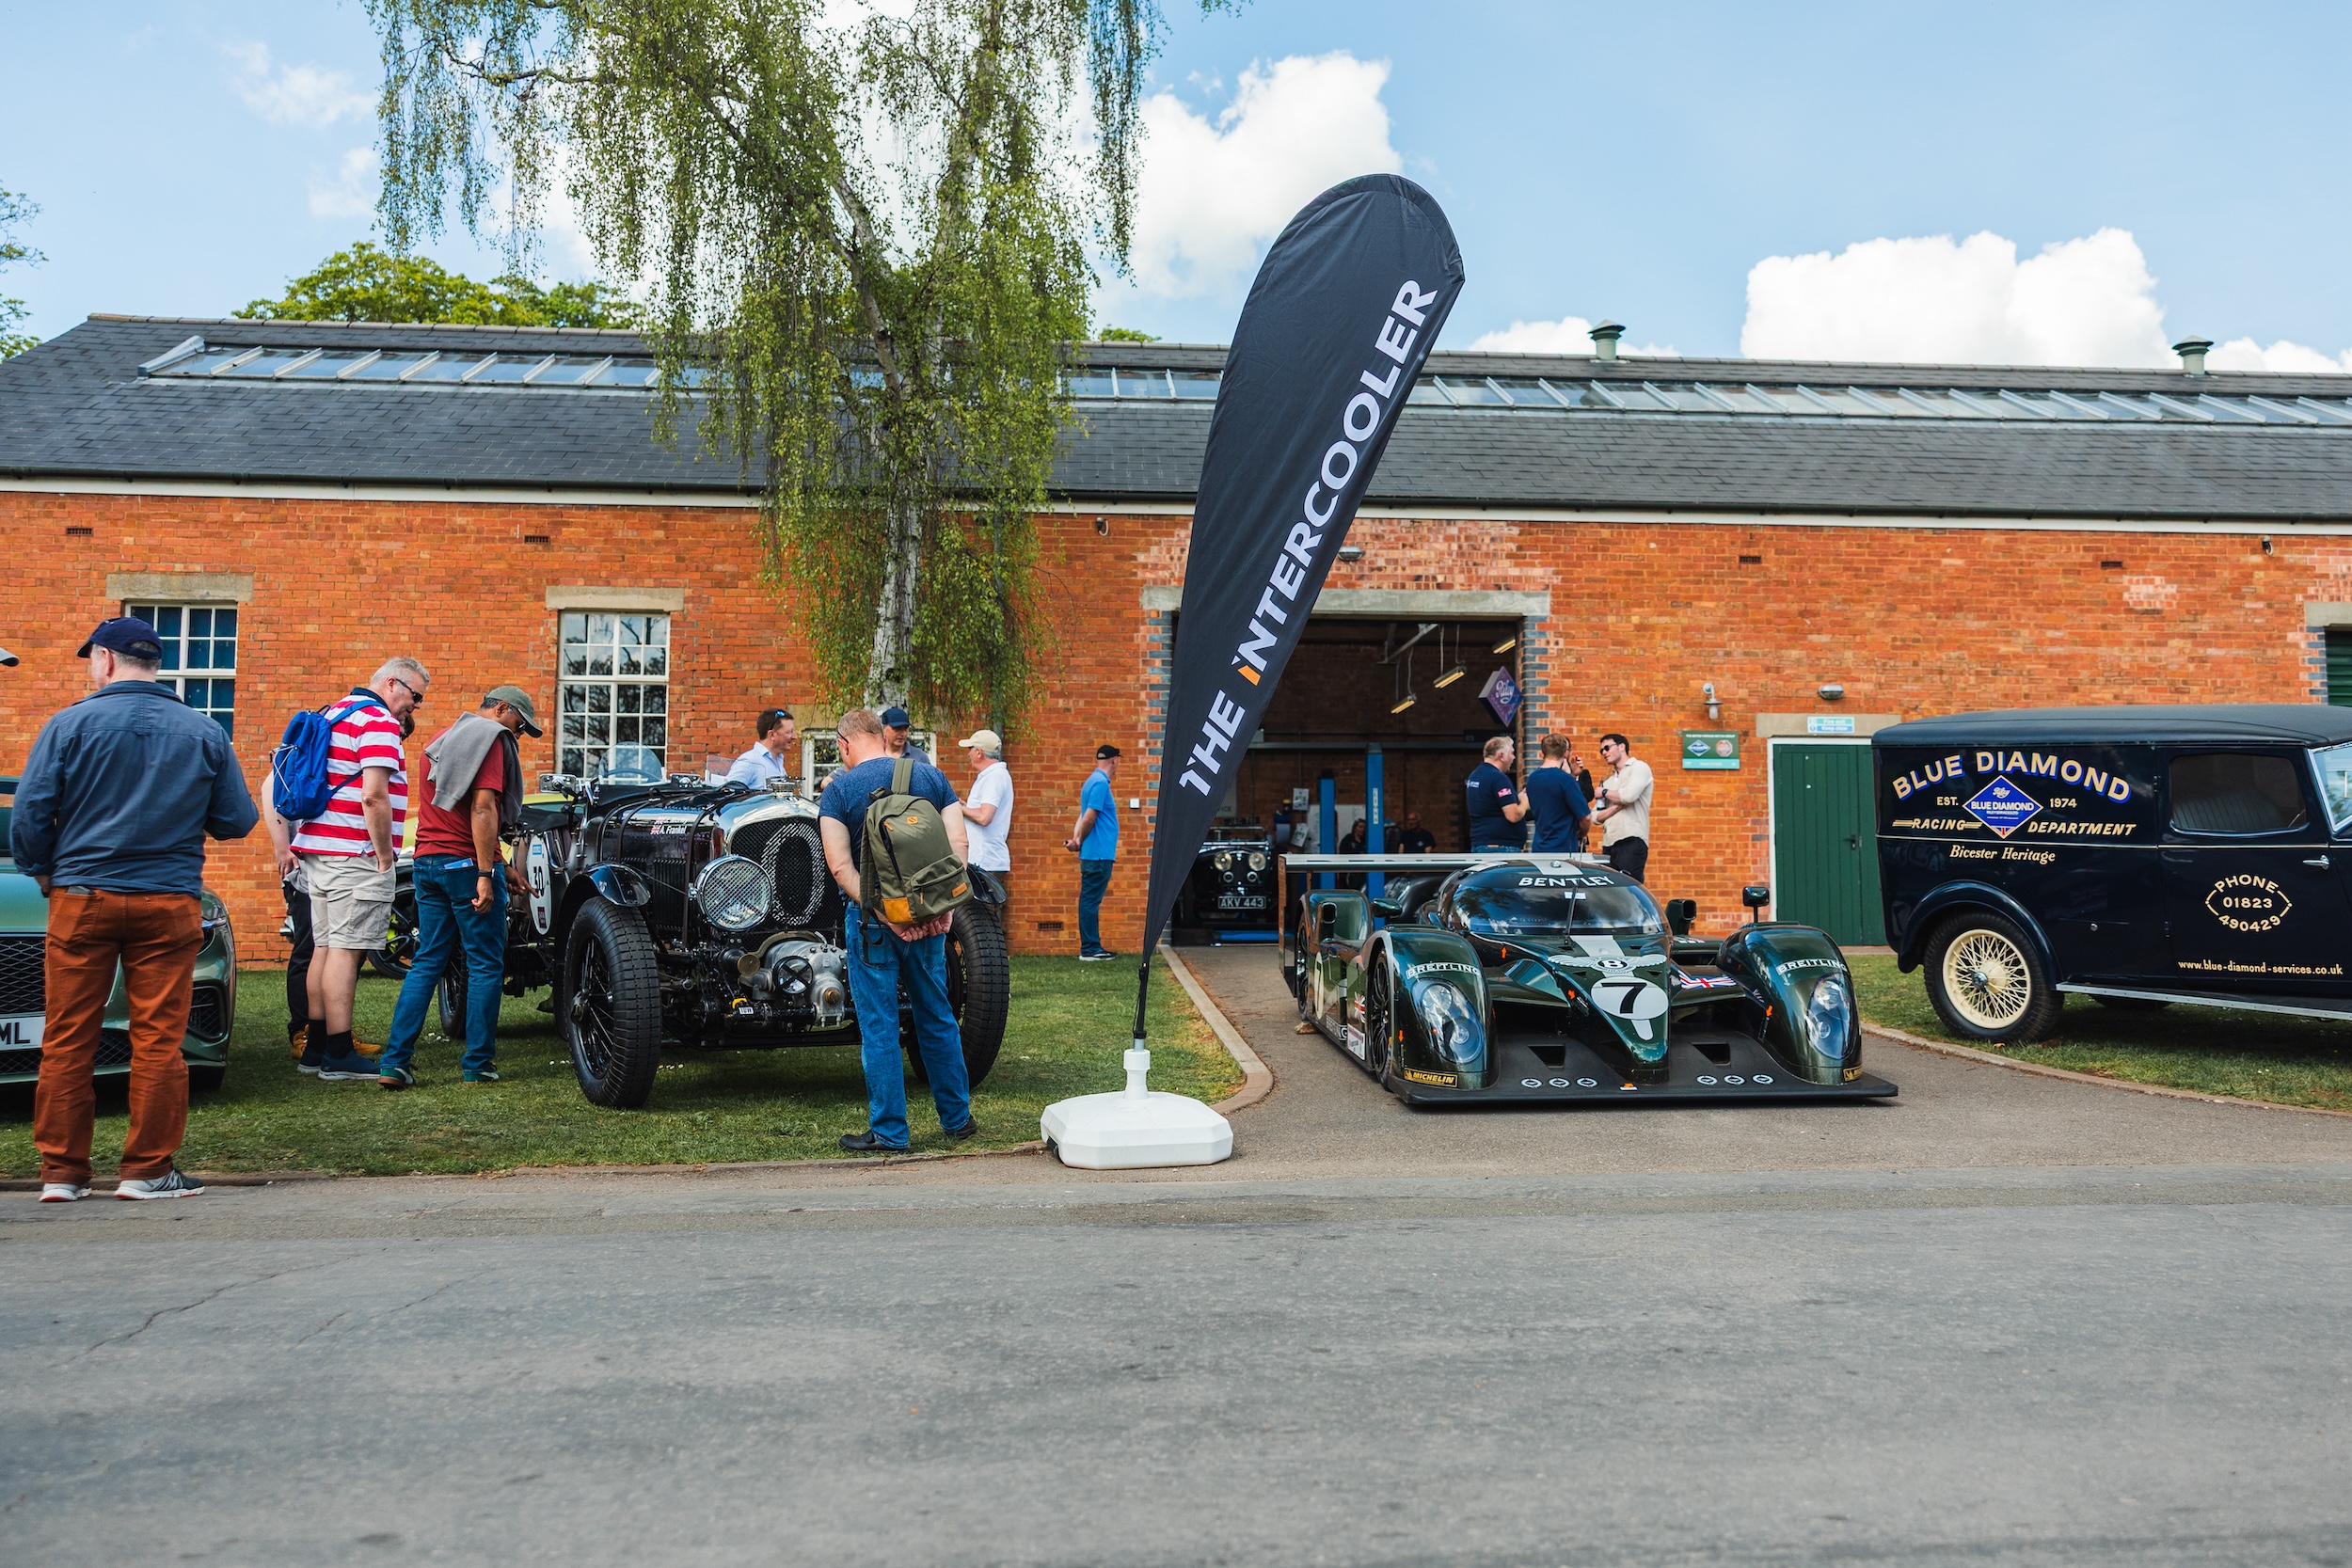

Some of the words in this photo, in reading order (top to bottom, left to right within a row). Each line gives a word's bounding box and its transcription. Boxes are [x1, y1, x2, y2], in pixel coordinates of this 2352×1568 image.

[1178, 689, 1247, 797] THE
[1232, 279, 1438, 686] INTERCOOLER
[1893, 755, 1964, 800] BLUE
[1977, 752, 2133, 802] DIAMOND
[1936, 796, 1959, 806] EST.
[2049, 798, 2077, 809] 1974
[1971, 800, 1992, 810] BLUE
[1992, 801, 2035, 811] DIAMOND
[1912, 817, 1965, 831] RACING
[2027, 821, 2137, 836] DEPARTMENT
[1949, 845, 1997, 860] Bicester
[2002, 847, 2056, 865] Heritage
[1518, 876, 1615, 887] BENTLEY
[2215, 874, 2279, 894] PHONE
[1220, 898, 1241, 907] AKV
[1243, 898, 1264, 907] 443
[2222, 896, 2273, 909] 01823
[2218, 914, 2281, 932] 490429
[1407, 963, 1482, 976] BREITLING
[1602, 959, 1625, 969] B
[1777, 958, 1848, 974] BREITLING
[2178, 958, 2344, 974] www.blue-diamond-services.co.uk
[1601, 982, 1647, 1014] 7
[0, 1022, 31, 1044] ML
[1412, 1072, 1454, 1084] MICHELIN
